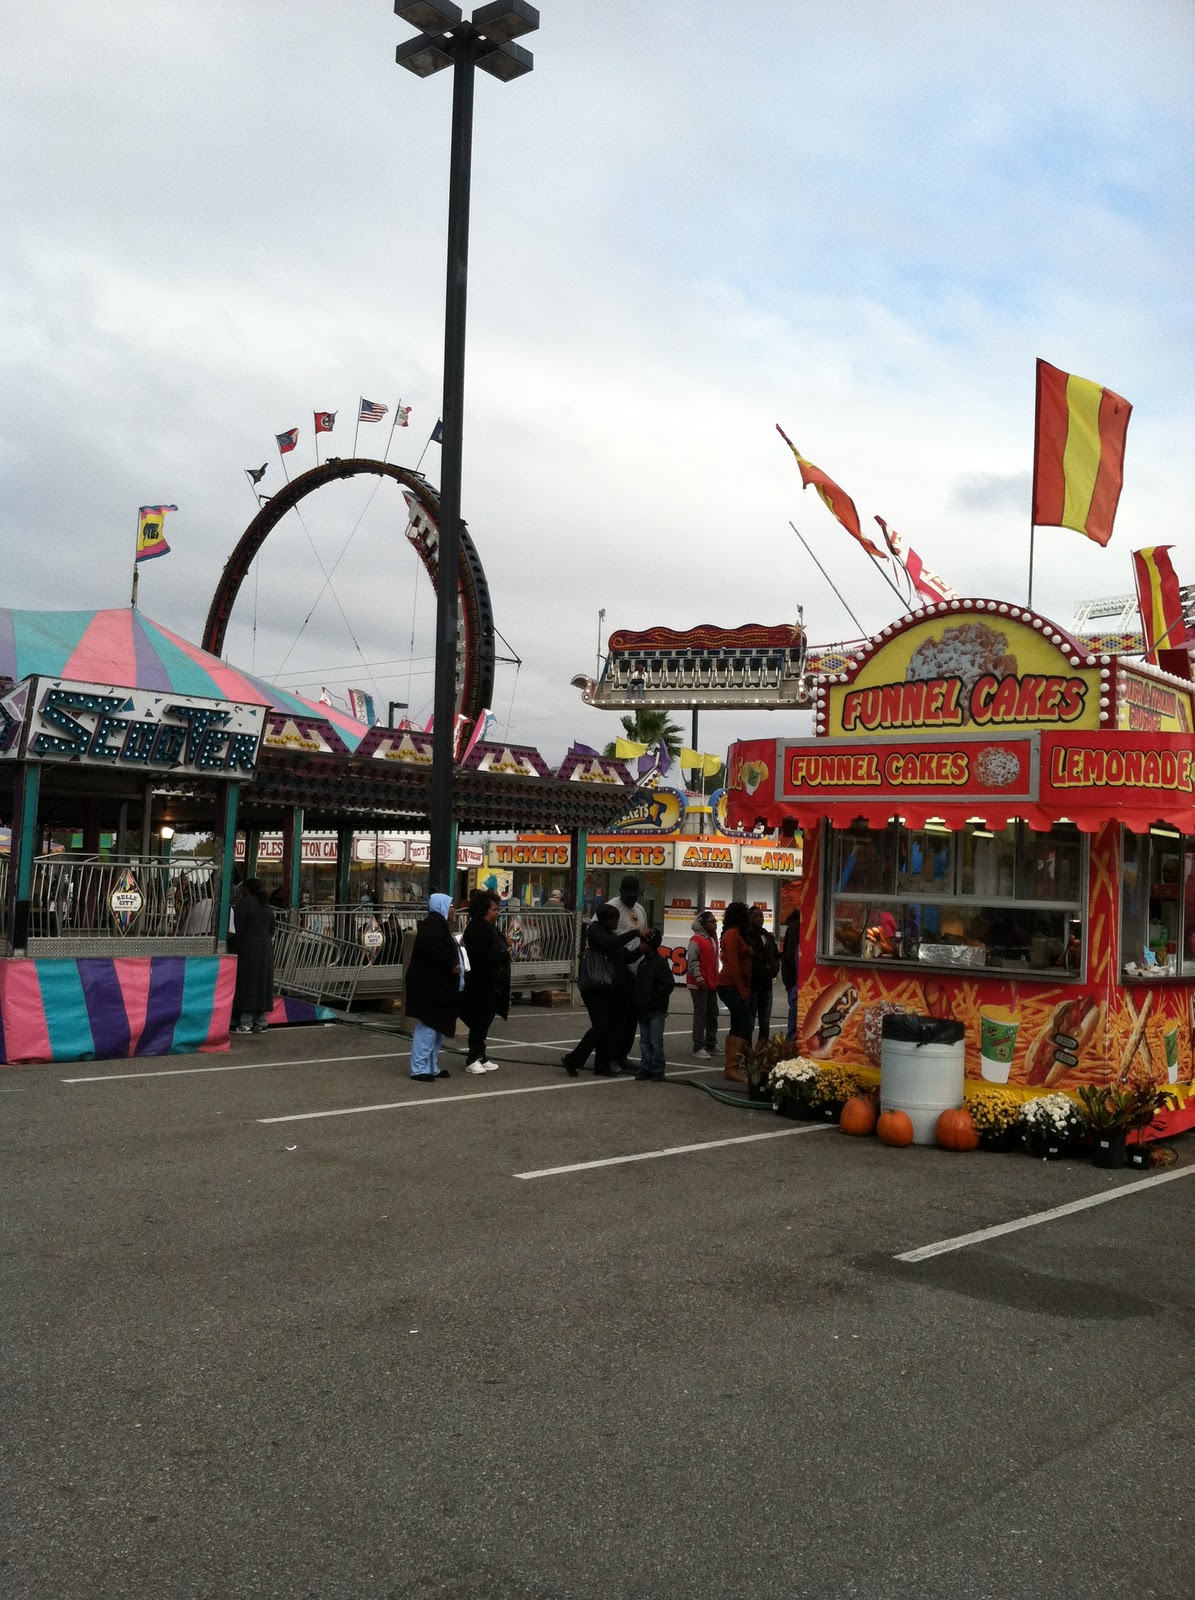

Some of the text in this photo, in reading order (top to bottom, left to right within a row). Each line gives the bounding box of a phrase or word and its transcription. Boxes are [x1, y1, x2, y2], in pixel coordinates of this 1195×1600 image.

[841, 674, 1090, 732] FUNNEL CAKES
[28, 687, 259, 772] SCOOTER
[790, 750, 969, 788] FUNNEL CAKES
[1050, 746, 1194, 793] LEMONADE
[496, 845, 569, 865] TICKETS
[586, 846, 665, 866] TICKETS
[684, 846, 732, 862] ATM
[761, 852, 795, 872] ATM
[682, 860, 734, 869] MACHINE
